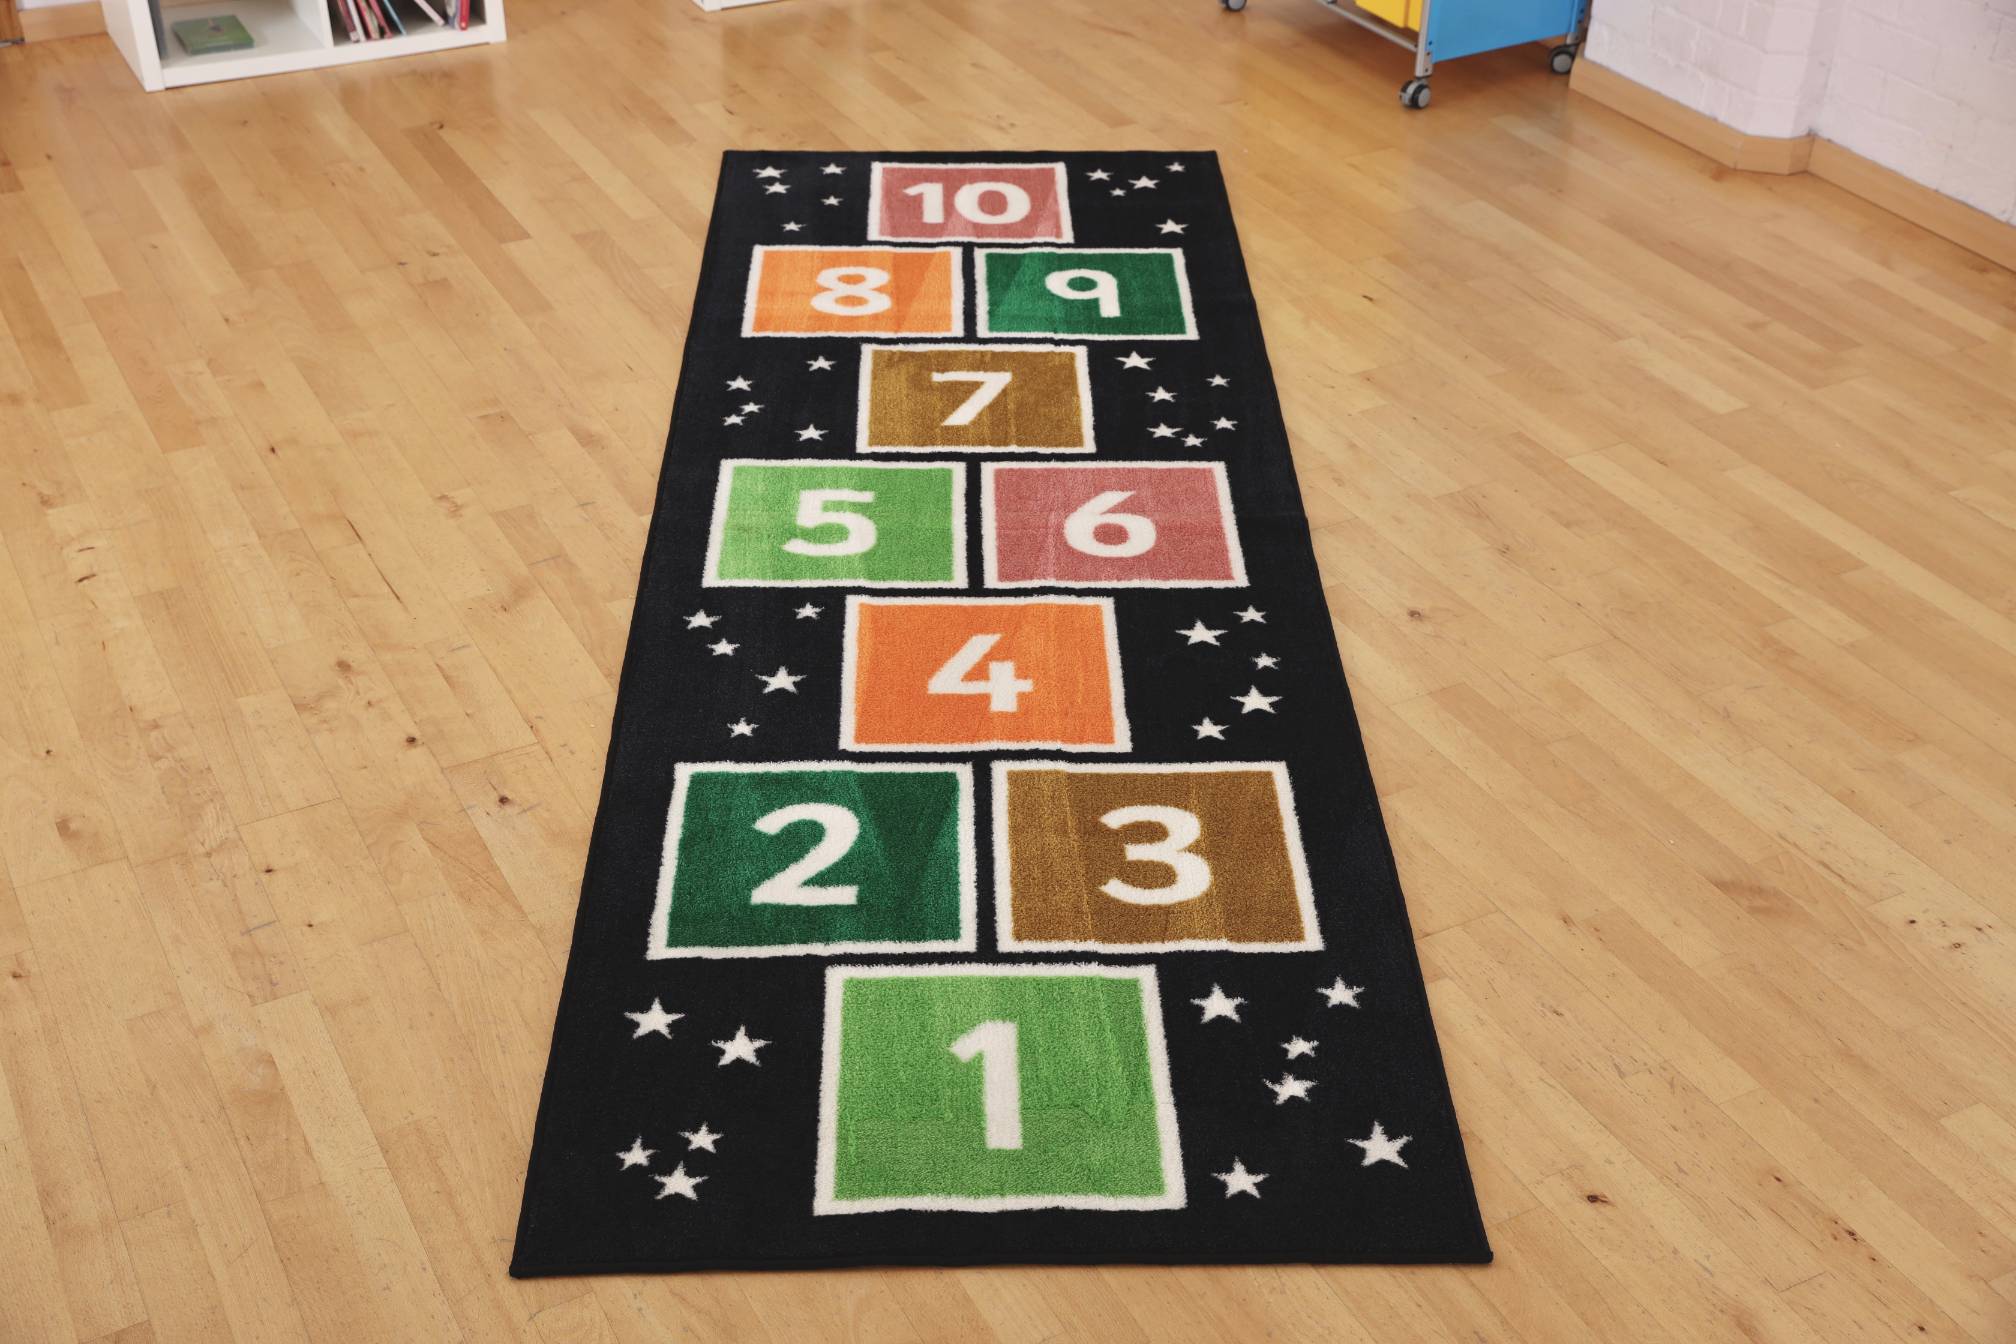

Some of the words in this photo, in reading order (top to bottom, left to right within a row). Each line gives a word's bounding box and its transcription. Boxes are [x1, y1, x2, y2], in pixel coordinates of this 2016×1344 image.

[902, 181, 1032, 225] 10
[810, 266, 892, 317] 8
[1044, 268, 1121, 318] 9
[930, 371, 1012, 426] 7
[782, 487, 878, 557] 5
[1062, 489, 1157, 557] 6
[927, 632, 1034, 713] 4
[750, 802, 861, 907] 2
[1100, 804, 1212, 906] 3
[949, 1019, 1023, 1150] 1
